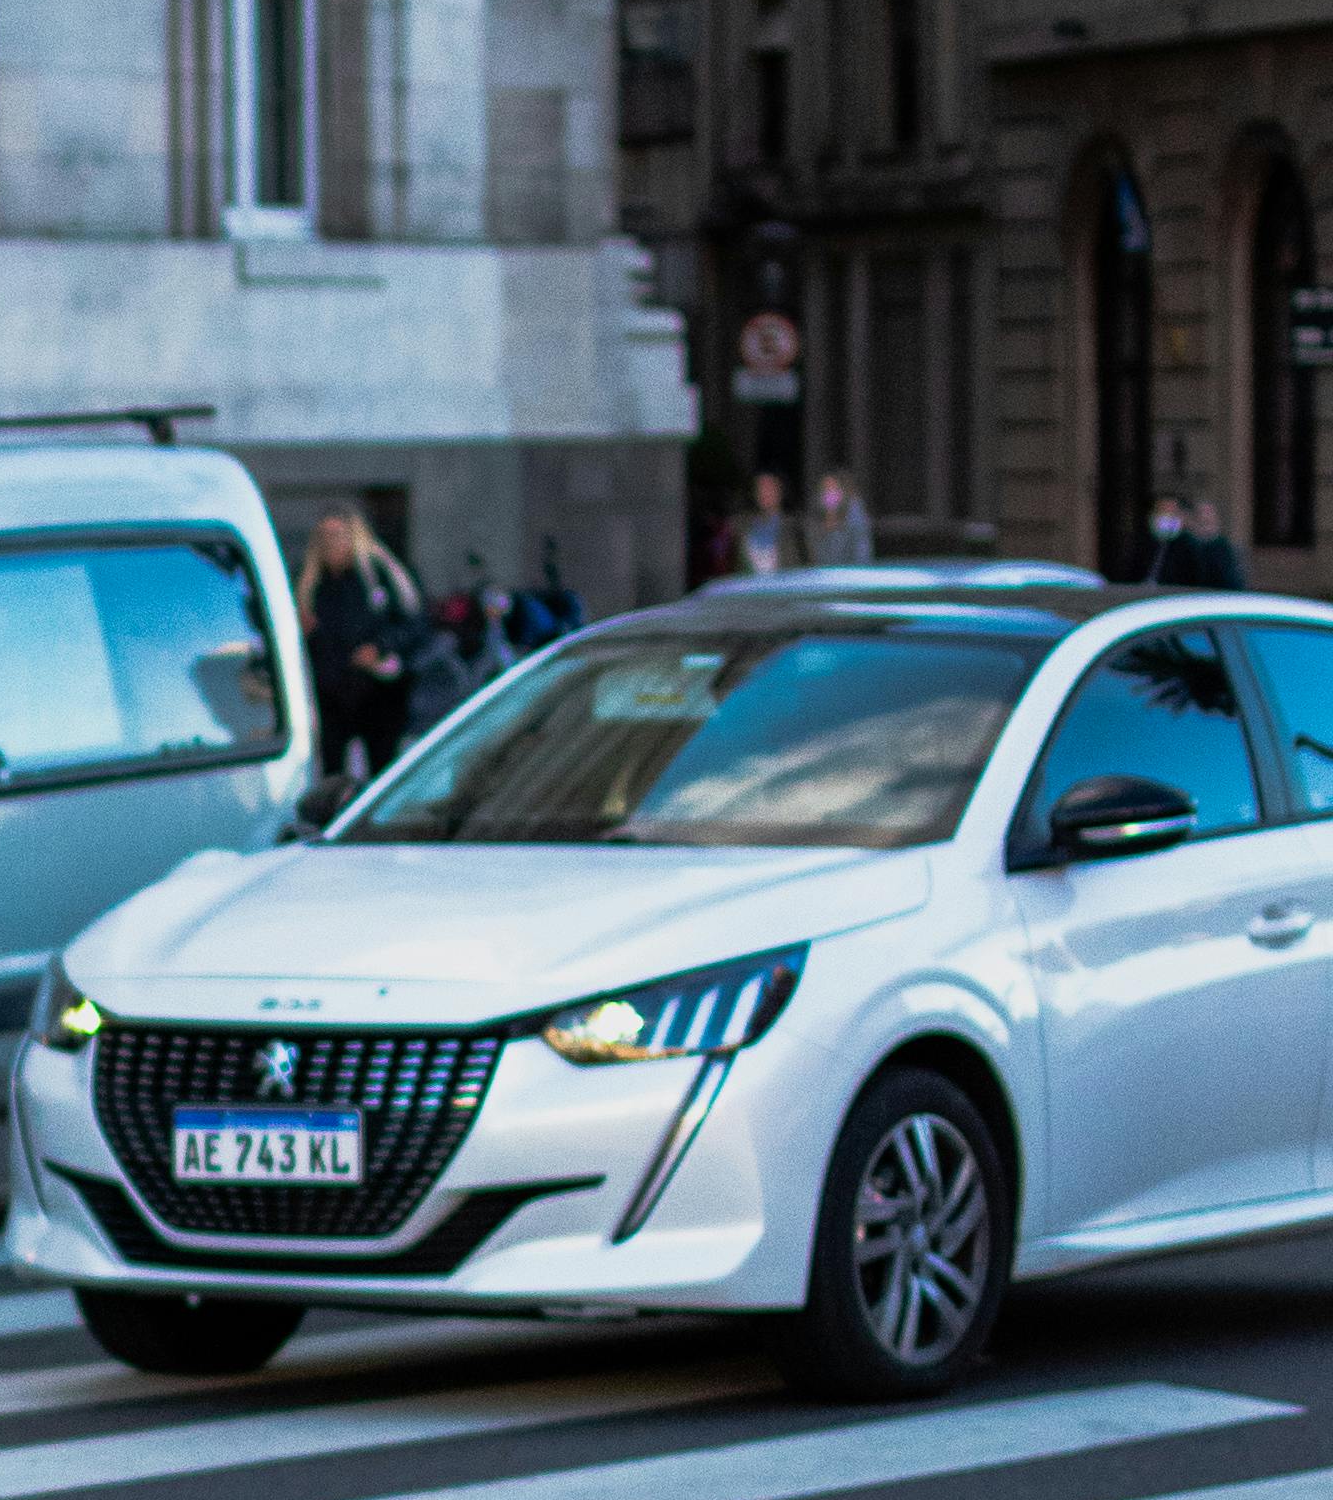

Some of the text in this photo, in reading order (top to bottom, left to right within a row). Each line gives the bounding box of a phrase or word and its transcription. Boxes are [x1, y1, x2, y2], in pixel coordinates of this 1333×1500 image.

[184, 1133, 351, 1175] AE 743 KL
